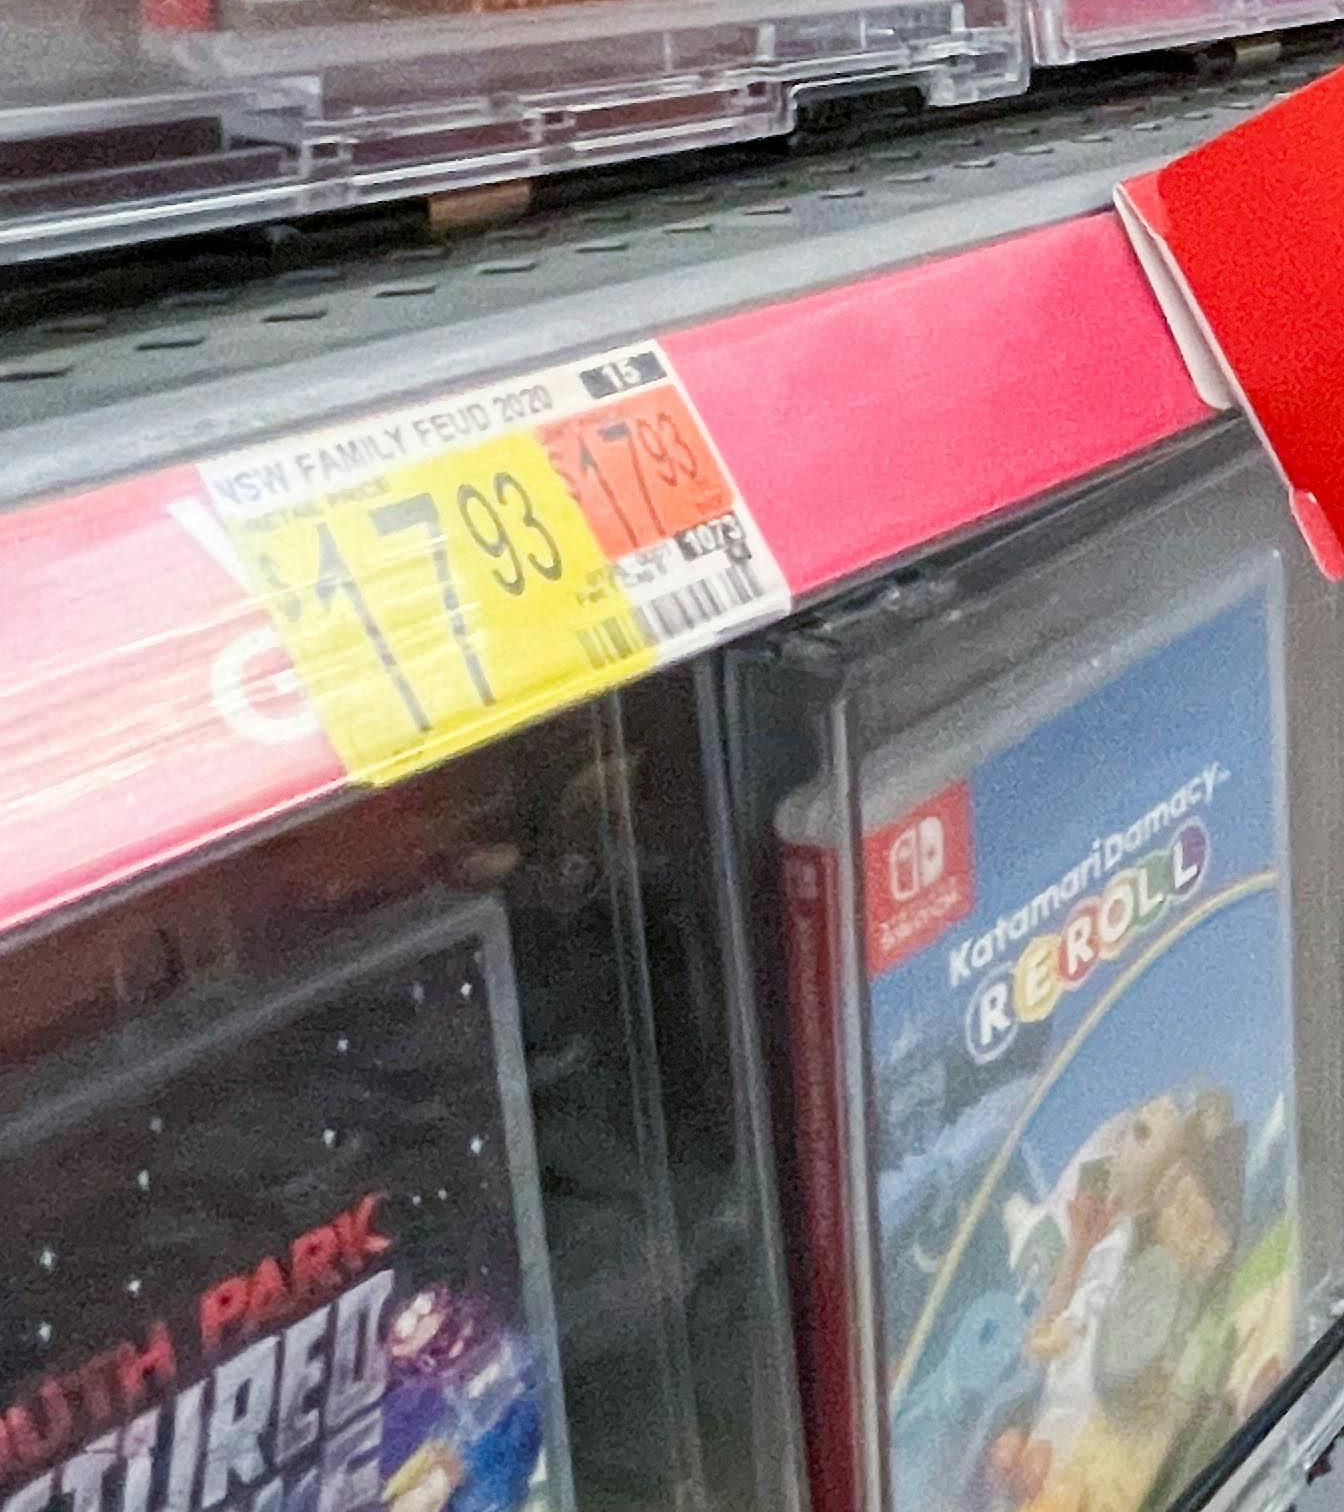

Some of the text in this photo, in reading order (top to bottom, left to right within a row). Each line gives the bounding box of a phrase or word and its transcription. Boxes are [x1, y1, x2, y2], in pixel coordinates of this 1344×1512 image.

[294, 426, 408, 485] FAMILY
[413, 401, 494, 447] FEUD
[492, 384, 555, 424] 2020
[602, 357, 643, 390] 15
[977, 838, 1202, 1048] REROLL
[198, 1191, 394, 1351] PARK
